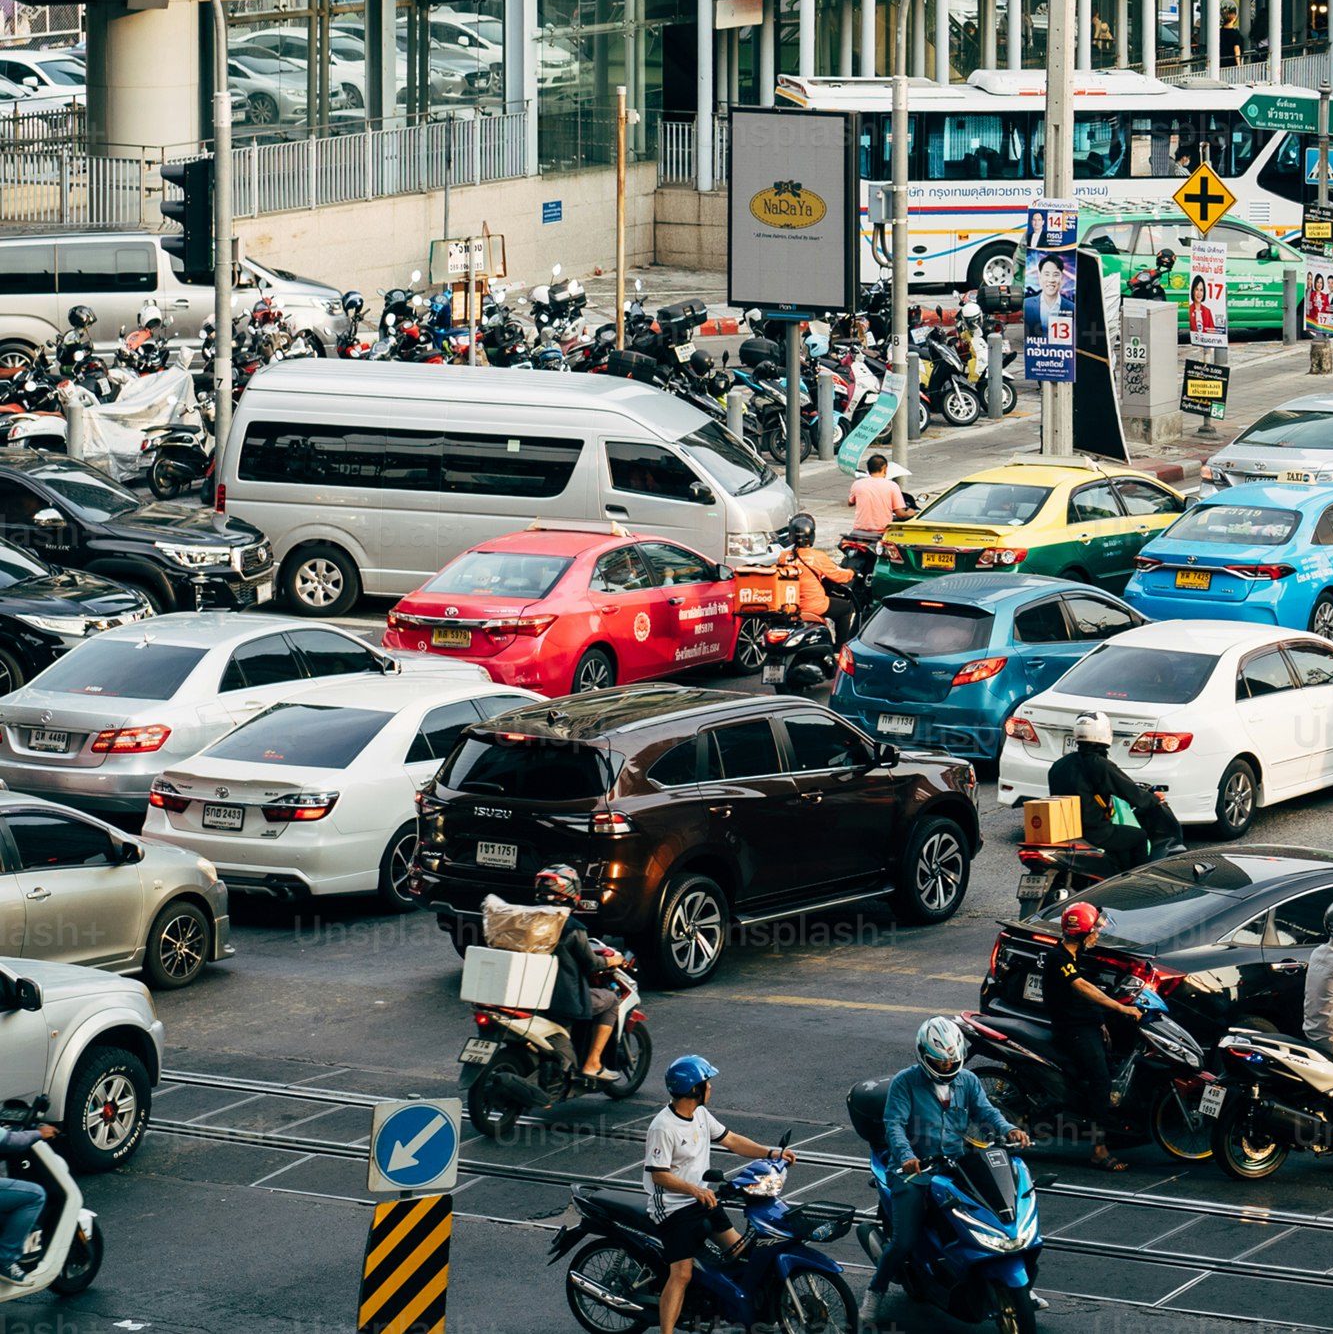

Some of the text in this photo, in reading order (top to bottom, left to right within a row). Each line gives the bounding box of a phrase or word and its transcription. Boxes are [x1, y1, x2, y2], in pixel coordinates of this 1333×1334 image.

[1267, 109, 1304, 122] ห้วยขวาง
[929, 185, 1032, 202] กรุงเทพดุสิตเวชการ
[768, 198, 814, 217] NaRaYa
[1048, 216, 1062, 230] 14
[1208, 283, 1224, 300] 17
[1319, 316, 1330, 326] 17
[1050, 322, 1071, 340] 13
[893, 336, 900, 347] 8
[1026, 348, 1073, 360] กอบกฤต
[1127, 347, 1146, 359] 382
[216, 377, 224, 389] 7
[1211, 406, 1224, 417] 64
[1287, 472, 1303, 482] TAXI
[753, 594, 773, 603] Food
[450, 629, 470, 641] 5979
[224, 808, 242, 820] 2433
[473, 805, 513, 819] ISUZU
[497, 845, 517, 857] 1751
